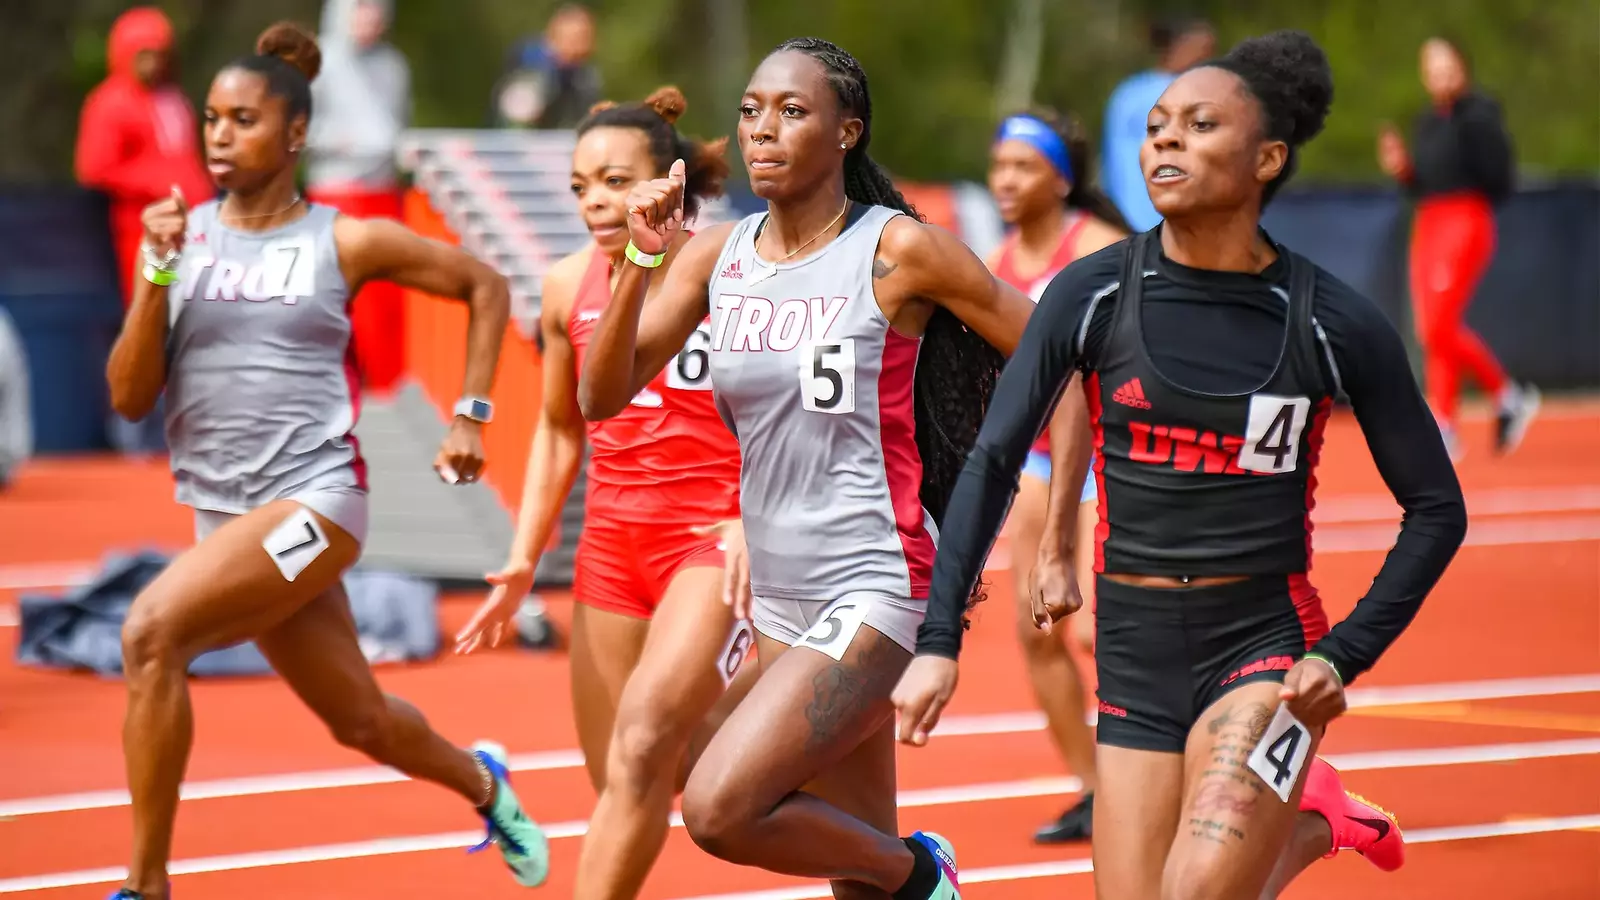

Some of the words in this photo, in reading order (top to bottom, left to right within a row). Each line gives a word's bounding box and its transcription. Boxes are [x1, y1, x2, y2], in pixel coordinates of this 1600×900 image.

[184, 256, 299, 305] TRO
[277, 246, 301, 288] 7
[712, 293, 849, 352] TROY
[677, 329, 710, 385] 6
[813, 344, 844, 409] 5
[1112, 393, 1152, 410] adidas
[1253, 403, 1297, 469] 4
[275, 520, 320, 560] 7
[805, 604, 857, 645] 5
[726, 627, 750, 678] 6
[1265, 723, 1303, 788] 4
